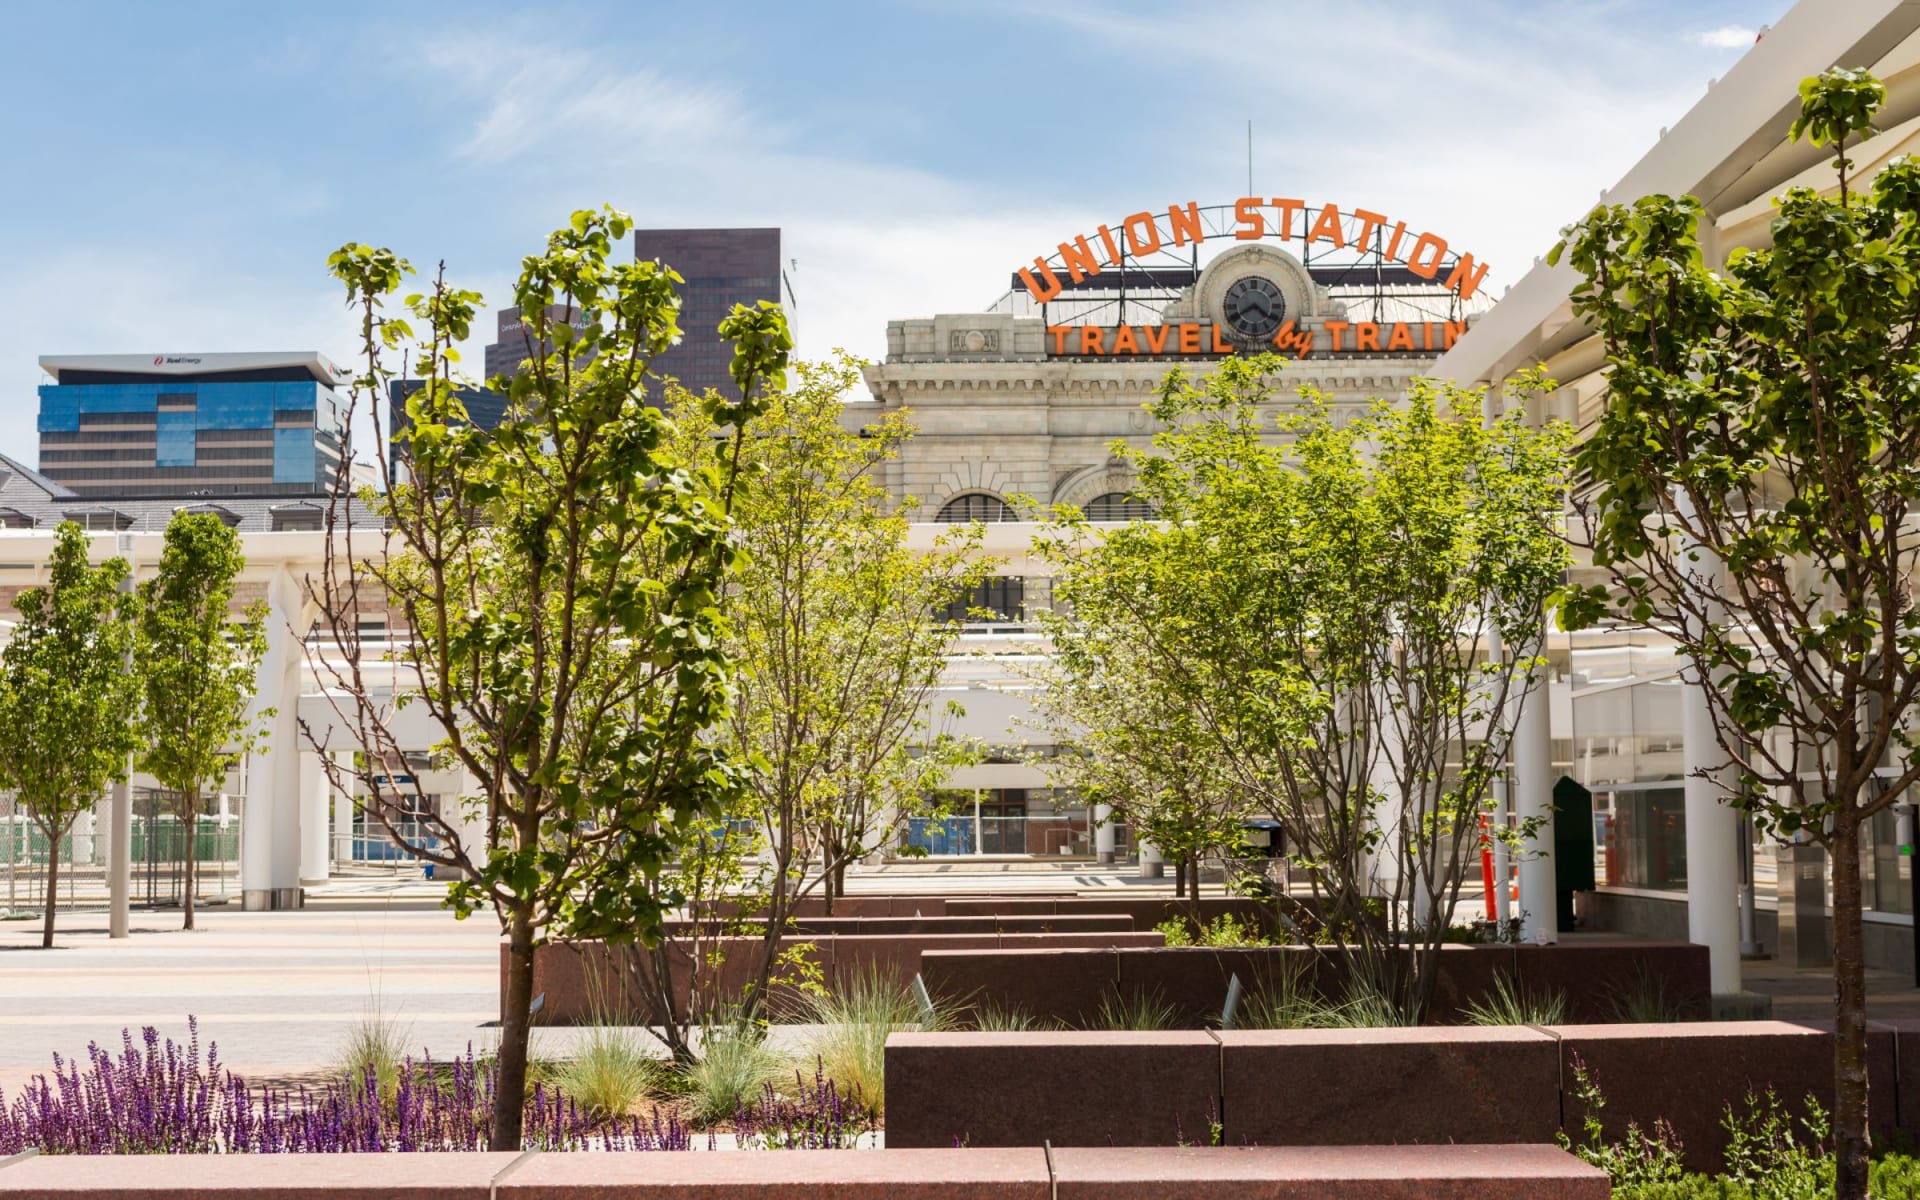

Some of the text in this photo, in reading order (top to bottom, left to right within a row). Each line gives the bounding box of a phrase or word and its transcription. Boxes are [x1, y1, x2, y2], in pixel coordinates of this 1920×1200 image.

[1018, 197, 1489, 304] UNION STATION
[1047, 320, 1466, 360] TRAVEL by TRAIN
